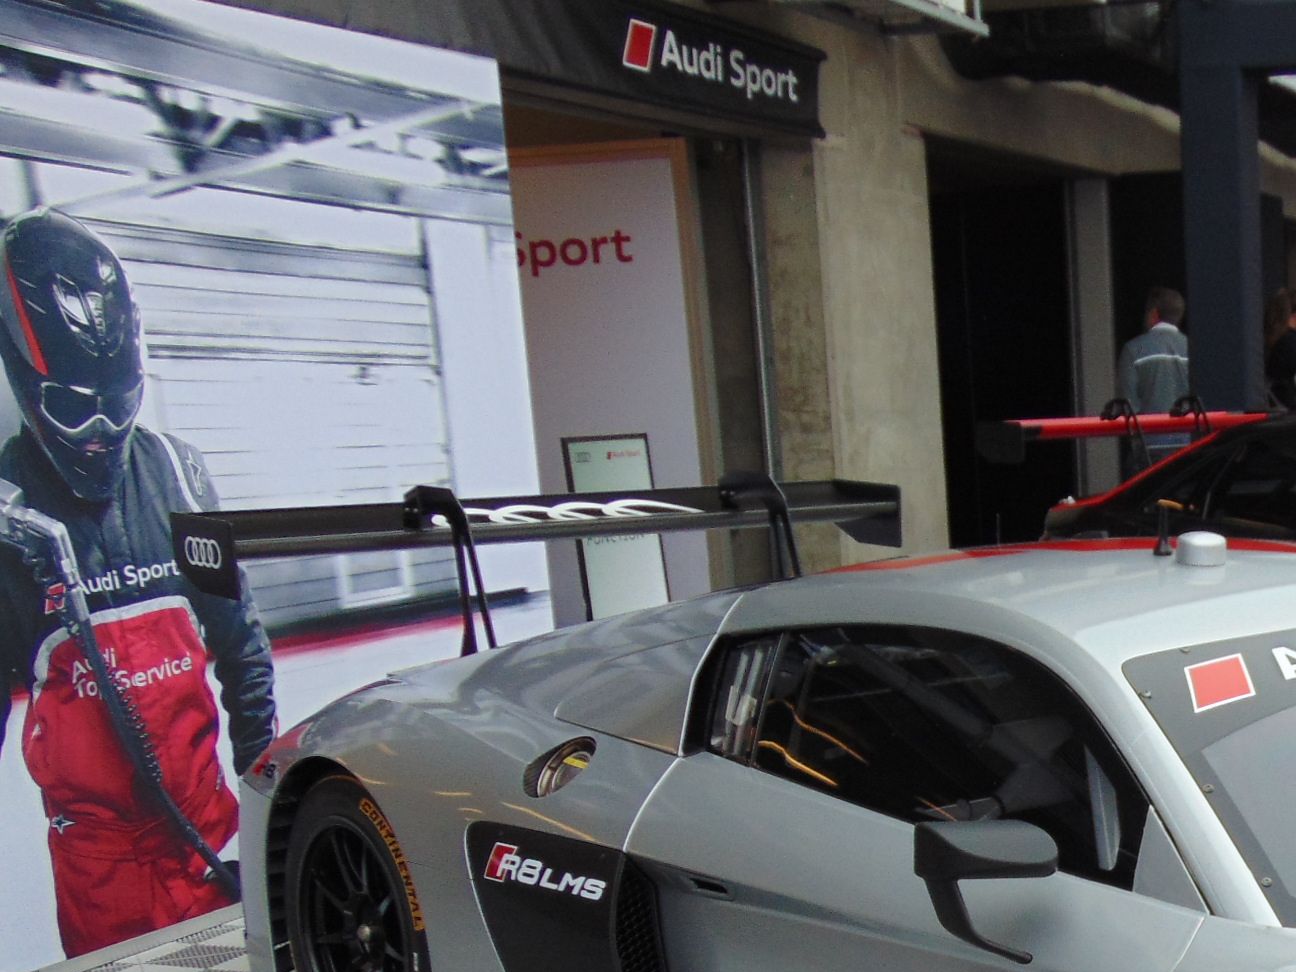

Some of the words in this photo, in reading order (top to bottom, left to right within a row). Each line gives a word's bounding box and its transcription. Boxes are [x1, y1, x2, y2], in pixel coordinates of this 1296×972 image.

[661, 30, 723, 82] Audi
[729, 50, 798, 103] Sport
[123, 559, 180, 587] Sport
[74, 679, 101, 699] To
[115, 652, 193, 691] Service
[360, 800, 424, 929] CONTINENTAL
